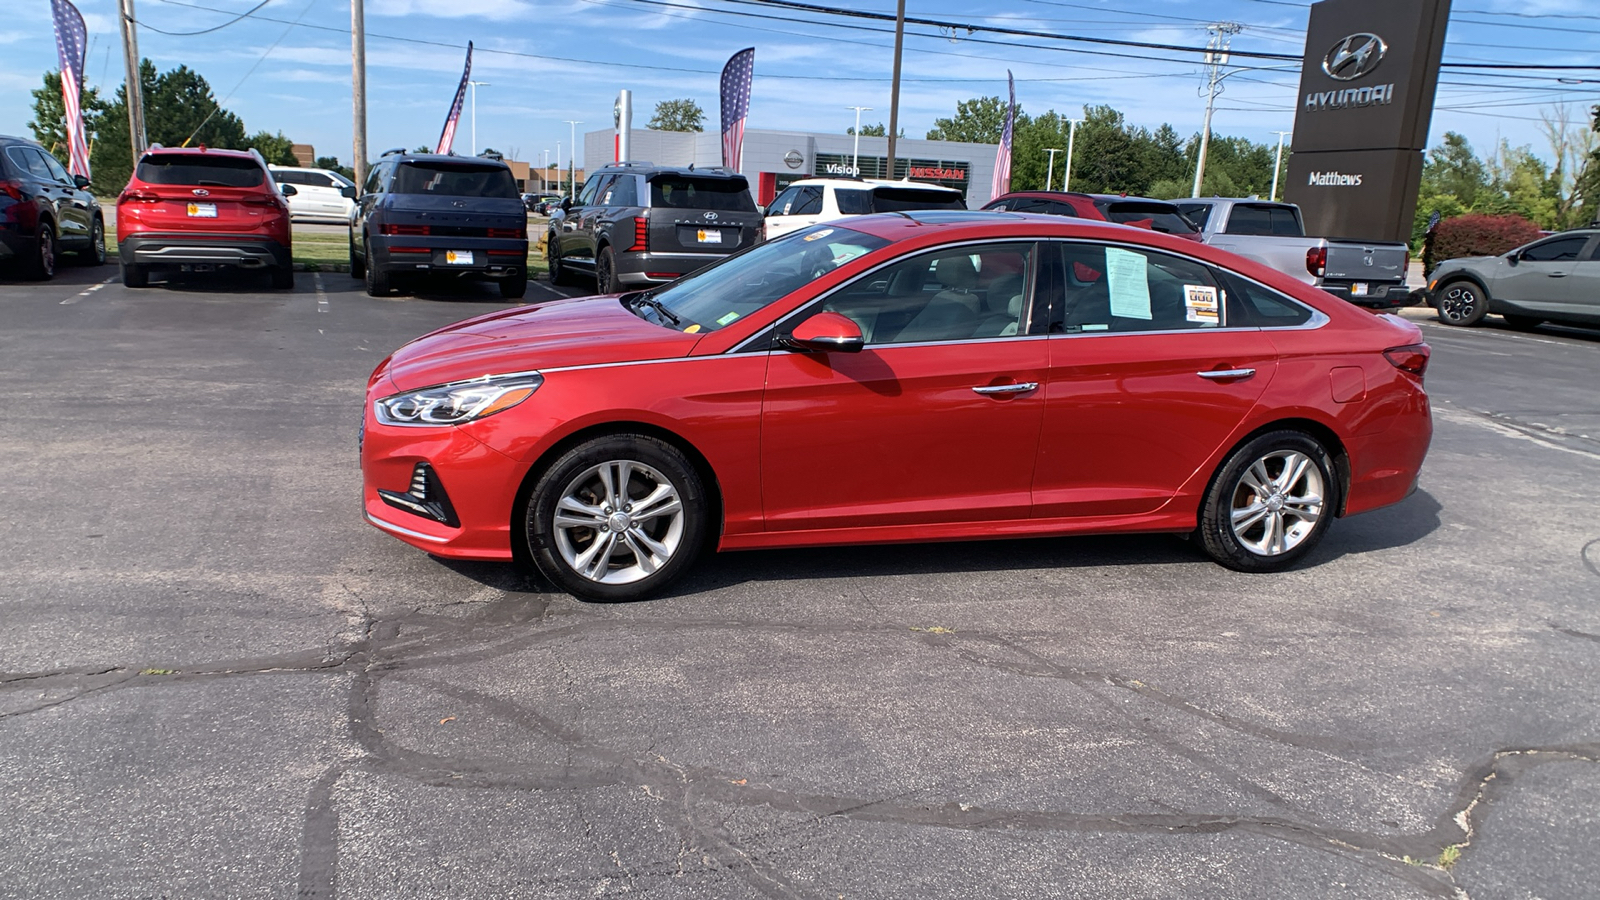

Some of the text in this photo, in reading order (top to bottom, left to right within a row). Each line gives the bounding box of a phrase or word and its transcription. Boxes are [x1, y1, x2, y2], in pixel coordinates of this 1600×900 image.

[1305, 84, 1394, 112] HYUNDAI
[826, 163, 860, 175] Vision
[910, 166, 965, 180] NISSAN
[1308, 171, 1363, 186] Matthews
